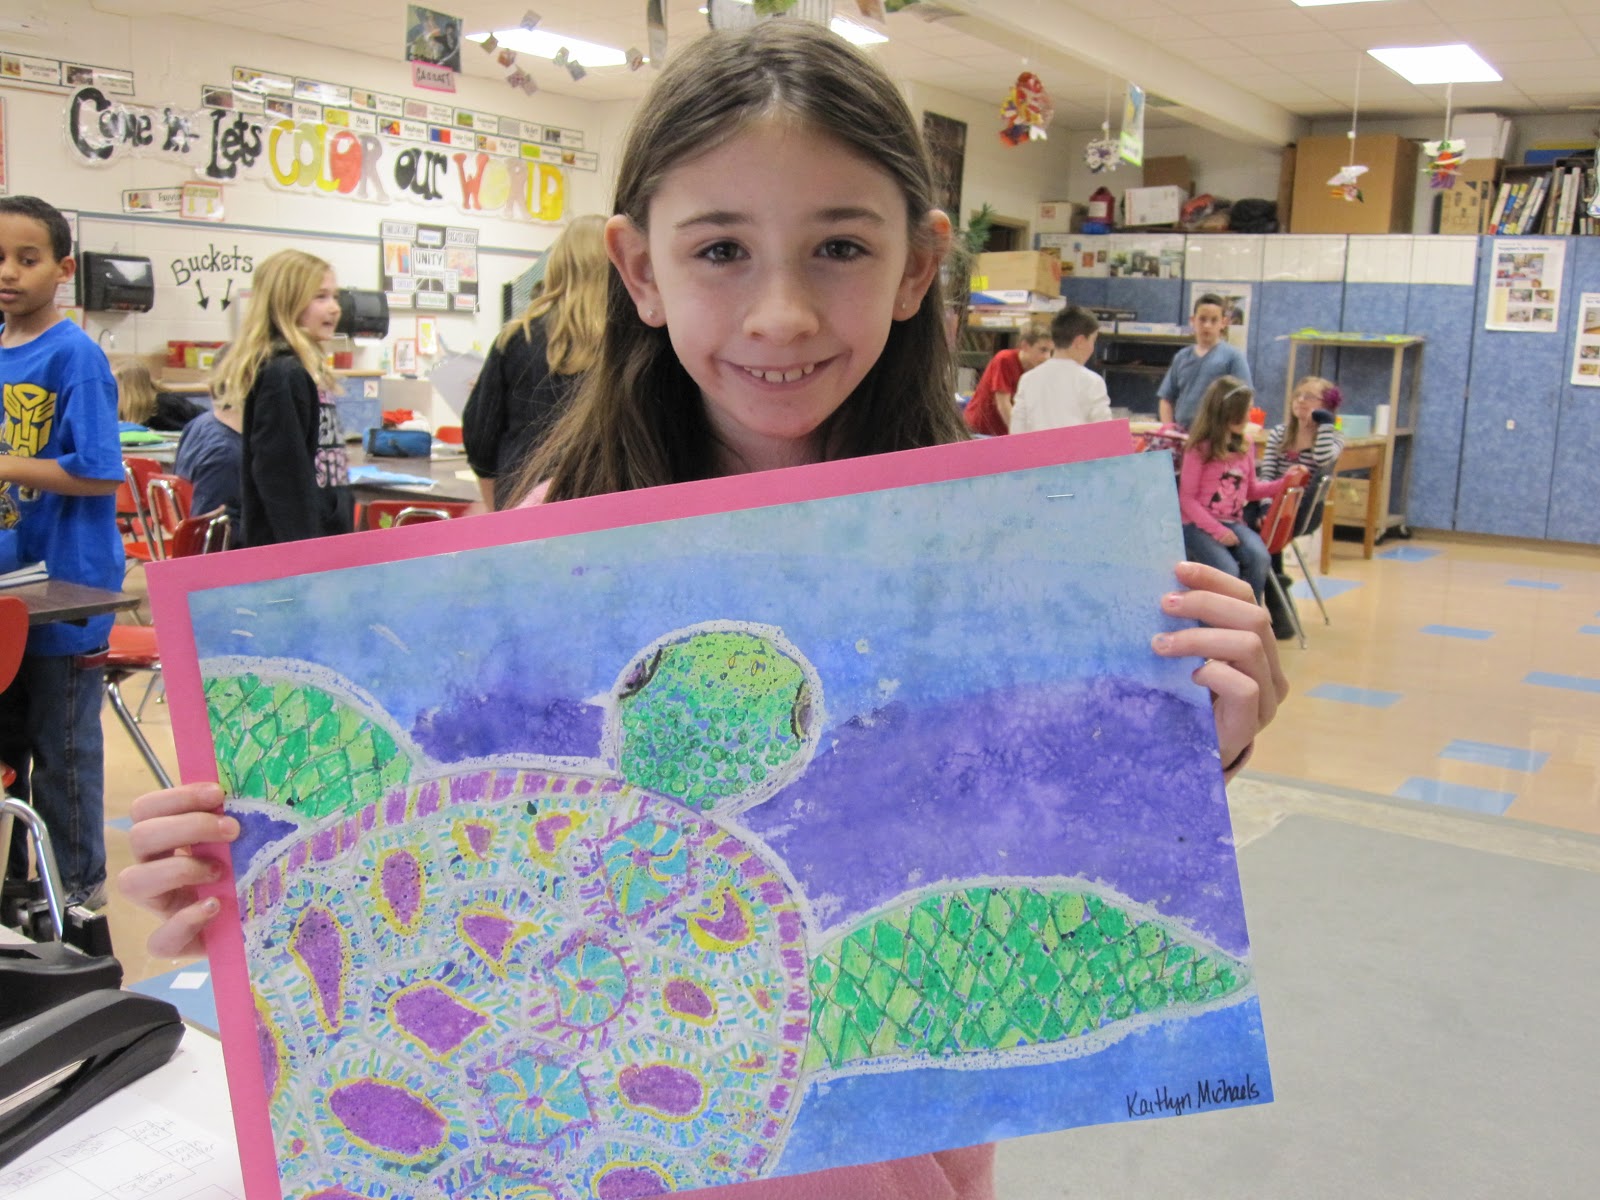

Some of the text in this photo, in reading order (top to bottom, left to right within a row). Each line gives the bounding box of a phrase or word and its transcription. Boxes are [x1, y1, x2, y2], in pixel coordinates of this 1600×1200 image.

[268, 119, 390, 203] COLOR
[395, 147, 448, 201] our
[453, 152, 564, 222] WORLD
[171, 243, 253, 286] Buckets
[415, 251, 443, 267] UNITY
[1126, 1073, 1260, 1117] Kaitlyn Michaels
